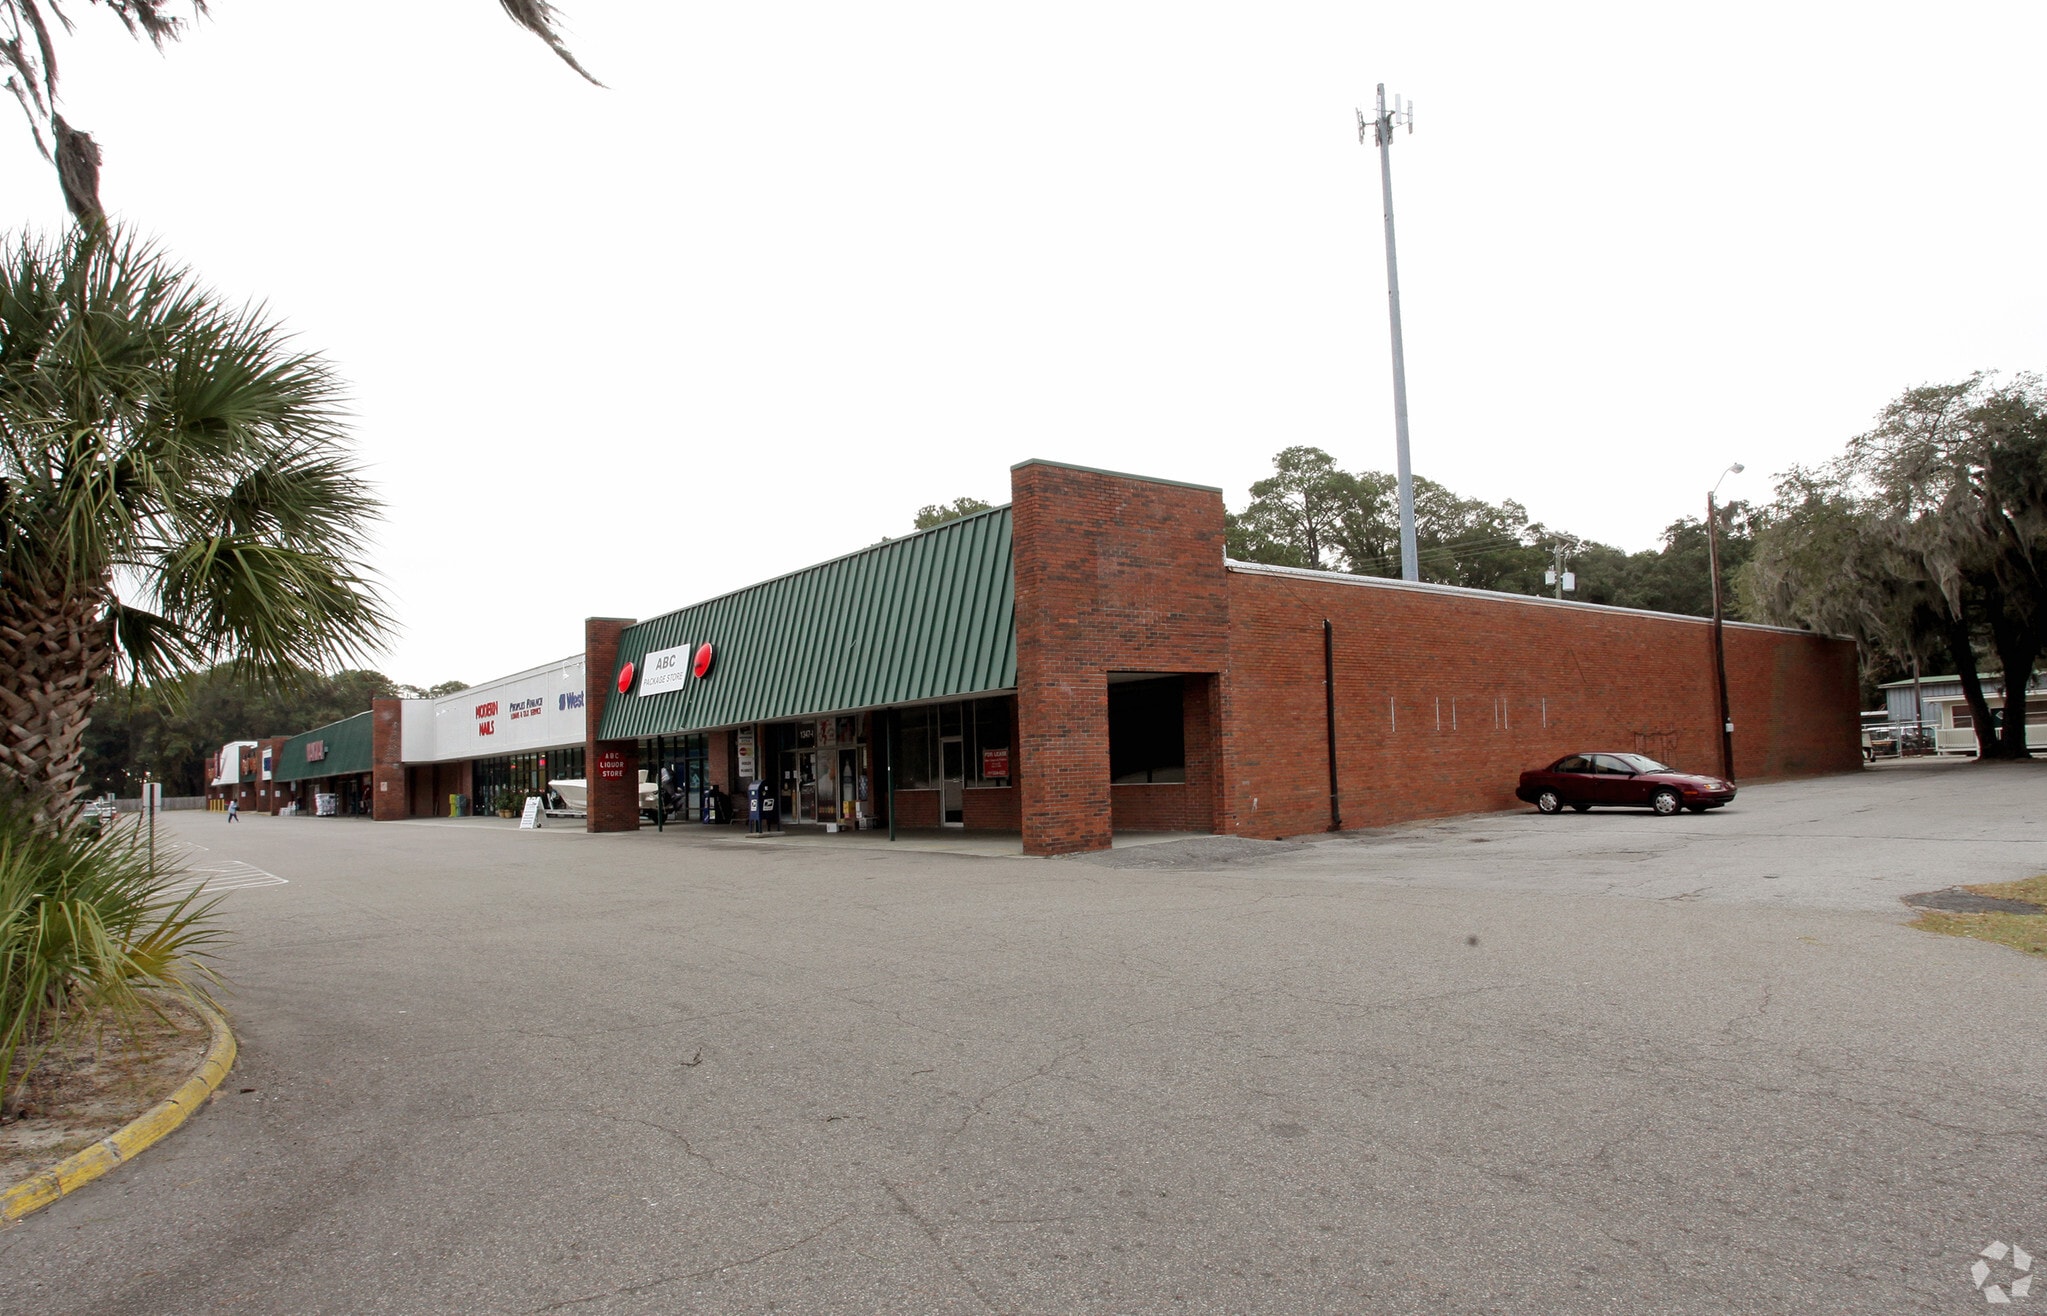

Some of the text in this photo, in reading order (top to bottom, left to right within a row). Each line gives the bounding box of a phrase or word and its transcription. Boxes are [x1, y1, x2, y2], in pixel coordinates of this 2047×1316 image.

[656, 655, 676, 670] ABC
[644, 672, 683, 686] PACKAGE STORE
[567, 691, 584, 709] West
[475, 701, 498, 719] MODERN
[479, 720, 494, 736] NAILS
